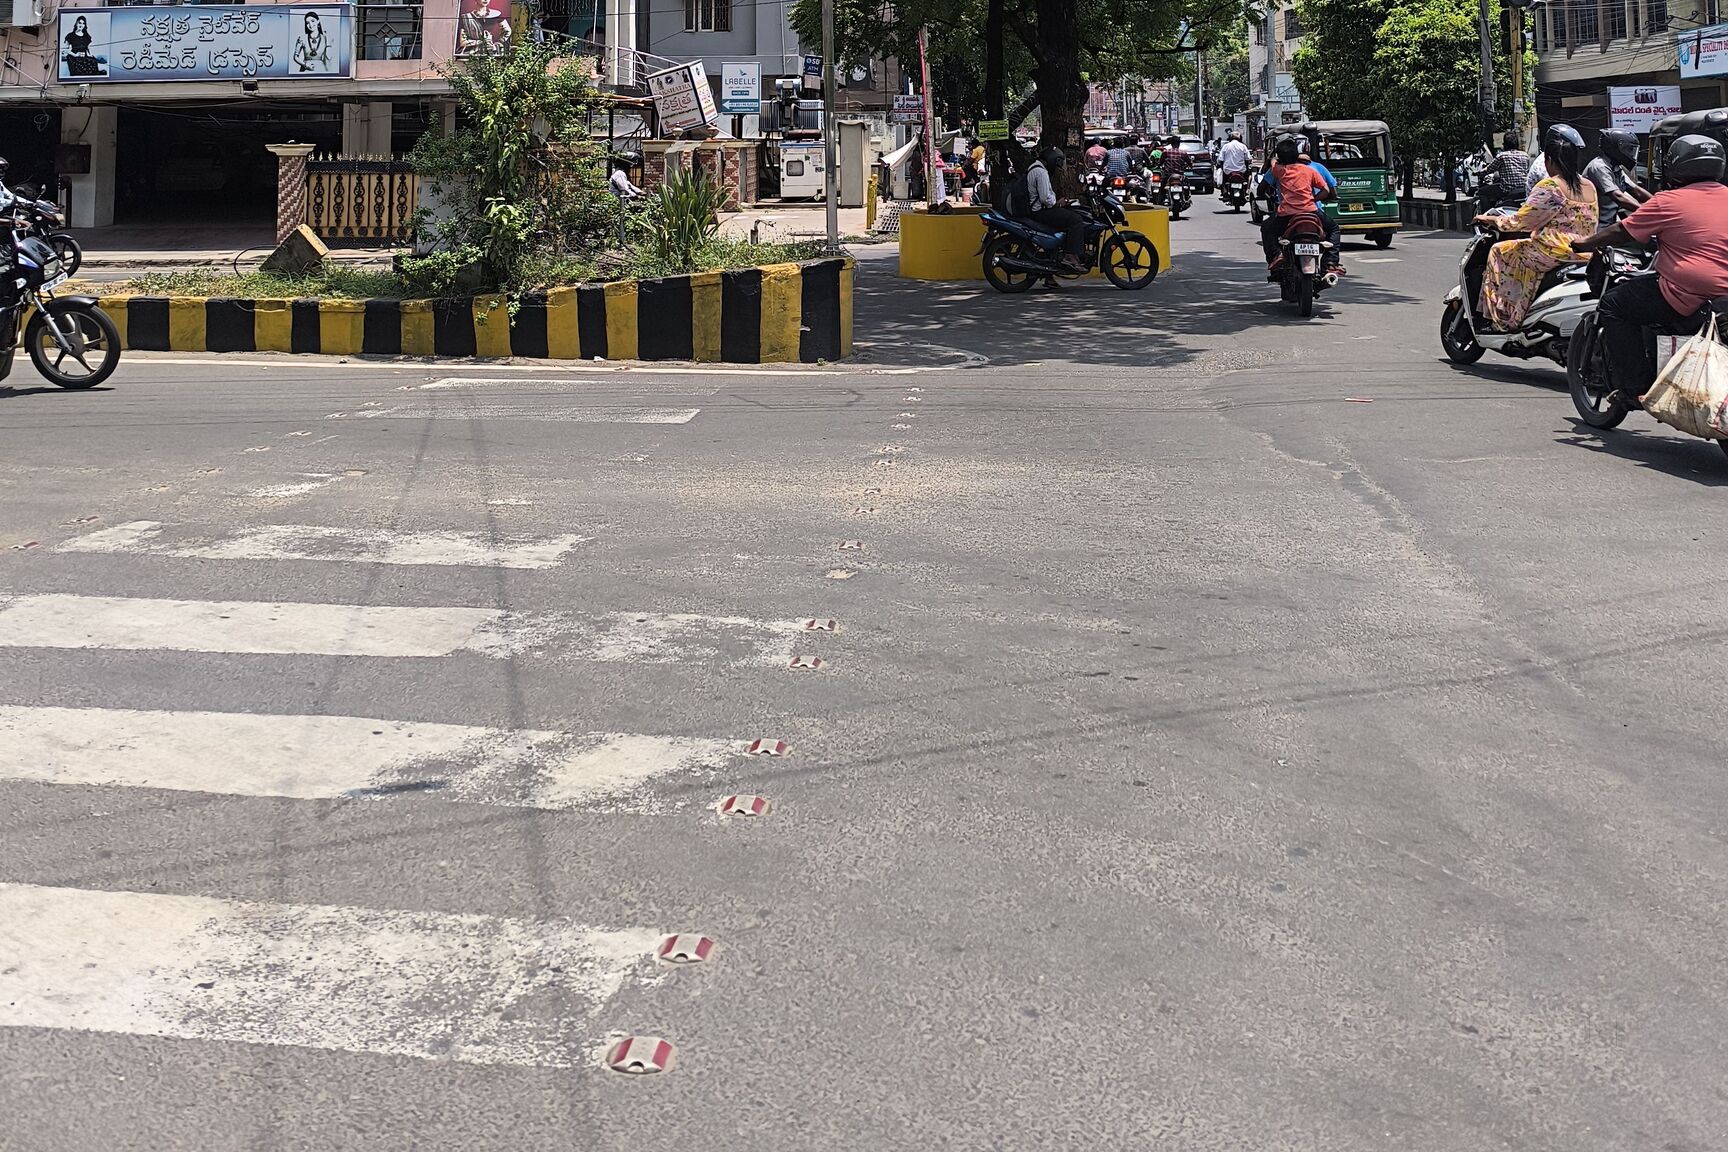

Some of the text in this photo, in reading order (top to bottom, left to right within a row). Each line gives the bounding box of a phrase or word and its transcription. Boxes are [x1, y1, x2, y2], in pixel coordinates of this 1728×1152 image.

[140, 12, 192, 44] నక్షత్ర
[120, 43, 275, 76] రెడీమేడ్ డ్రస్సెస్
[724, 77, 757, 85] LABELLE
